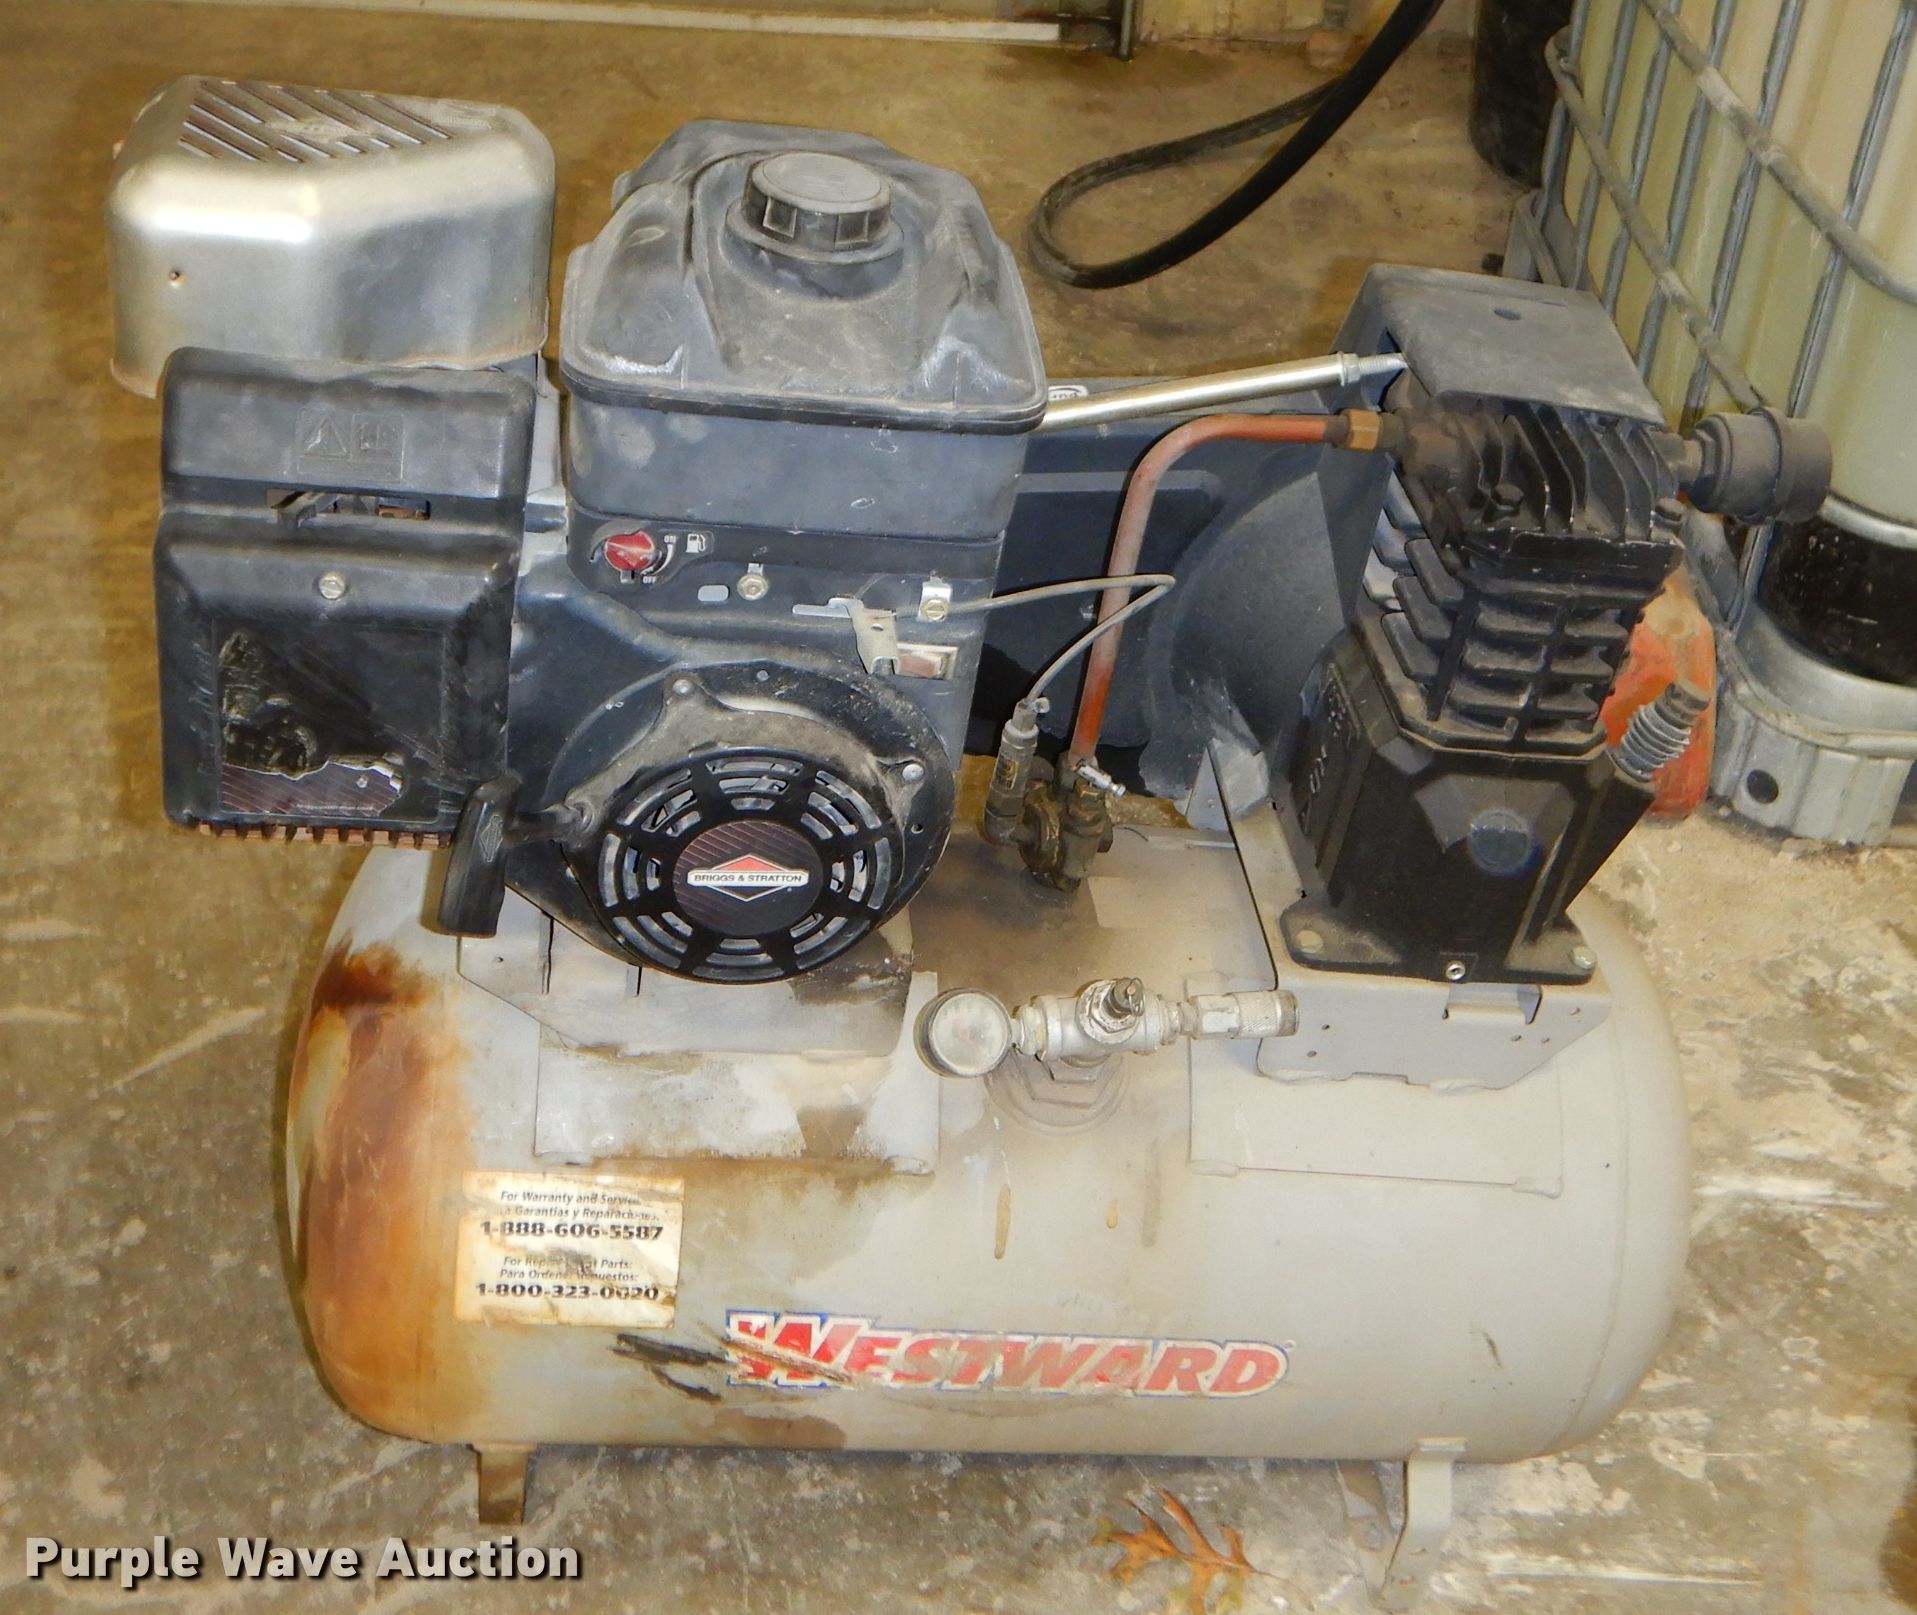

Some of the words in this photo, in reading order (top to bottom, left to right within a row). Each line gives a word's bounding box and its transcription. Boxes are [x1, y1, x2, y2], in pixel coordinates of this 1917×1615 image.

[694, 874, 735, 882] BRIGGS
[748, 874, 802, 883] STRATTON
[501, 1190, 518, 1201] For
[522, 1191, 573, 1206] Warranty
[576, 1193, 599, 1204] and
[573, 1207, 580, 1219] y
[480, 1221, 664, 1241] 1-888-606-5587
[504, 1256, 521, 1266] For
[601, 1259, 633, 1270] Parts:
[500, 1269, 524, 1279] Para
[577, 1271, 639, 1282] Rpuestos:
[726, 1308, 1290, 1397] WESTWARD
